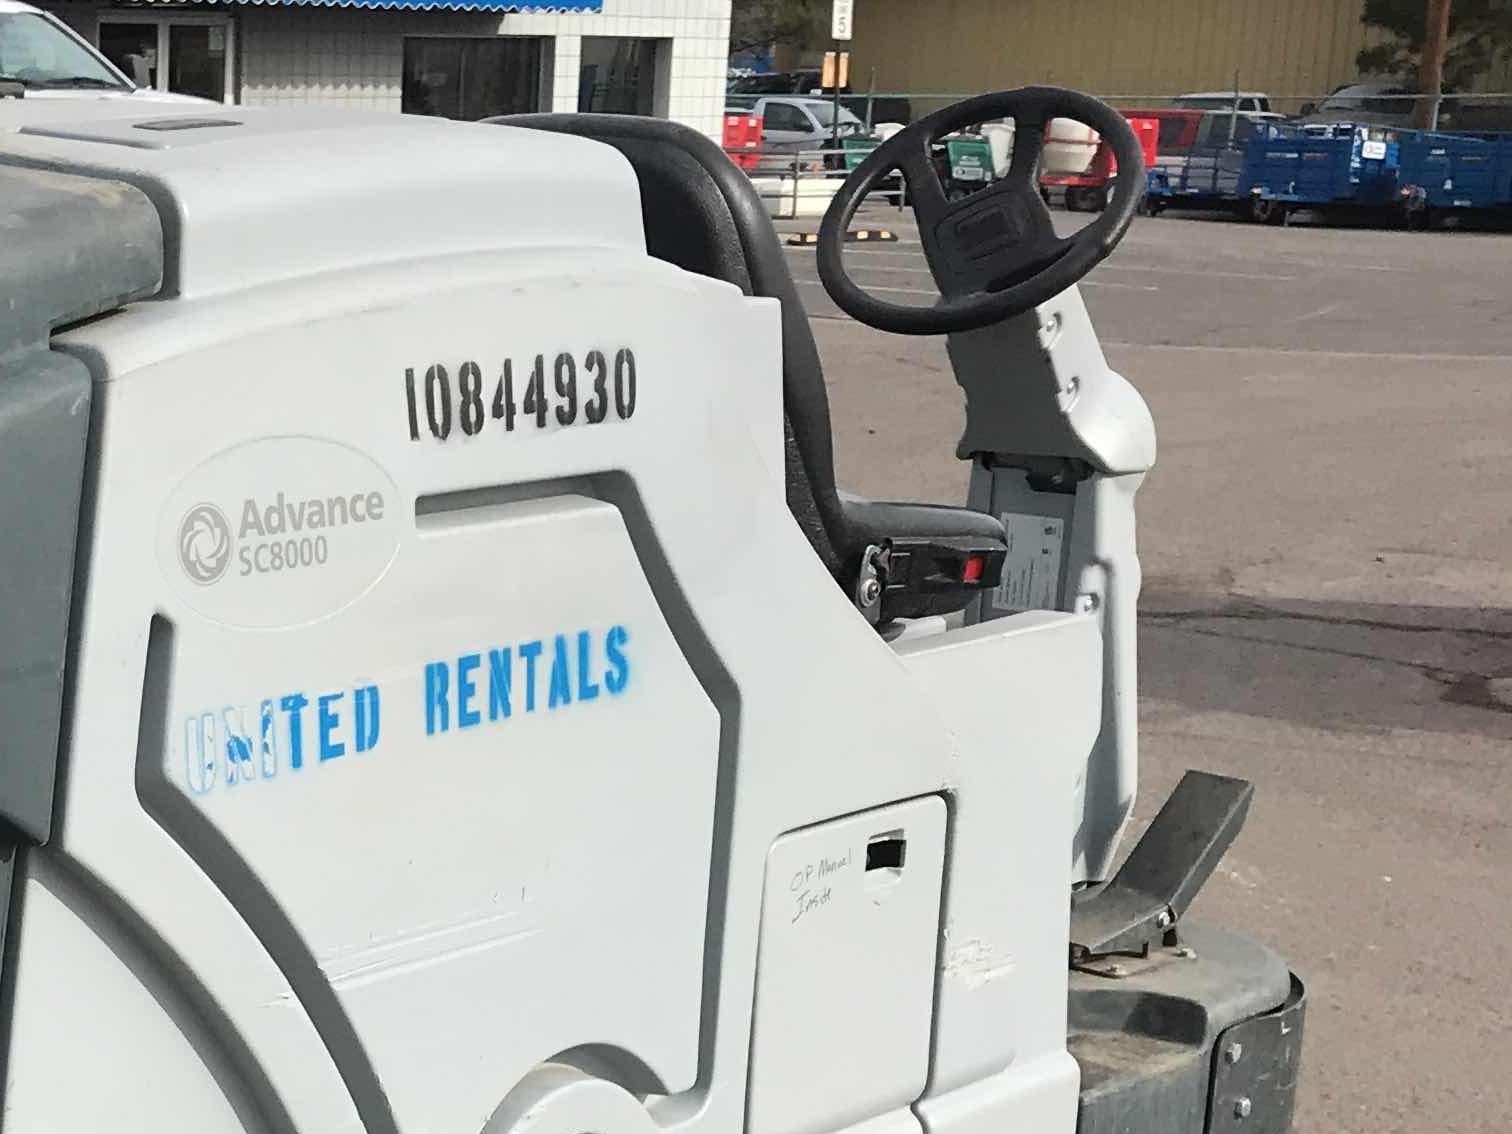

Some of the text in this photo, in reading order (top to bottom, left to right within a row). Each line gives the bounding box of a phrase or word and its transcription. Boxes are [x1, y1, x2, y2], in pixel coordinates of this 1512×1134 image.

[405, 347, 636, 441] 10844930
[238, 491, 385, 539] Advance
[239, 535, 328, 576] SC8000
[186, 624, 630, 795] UNITED RENTALS
